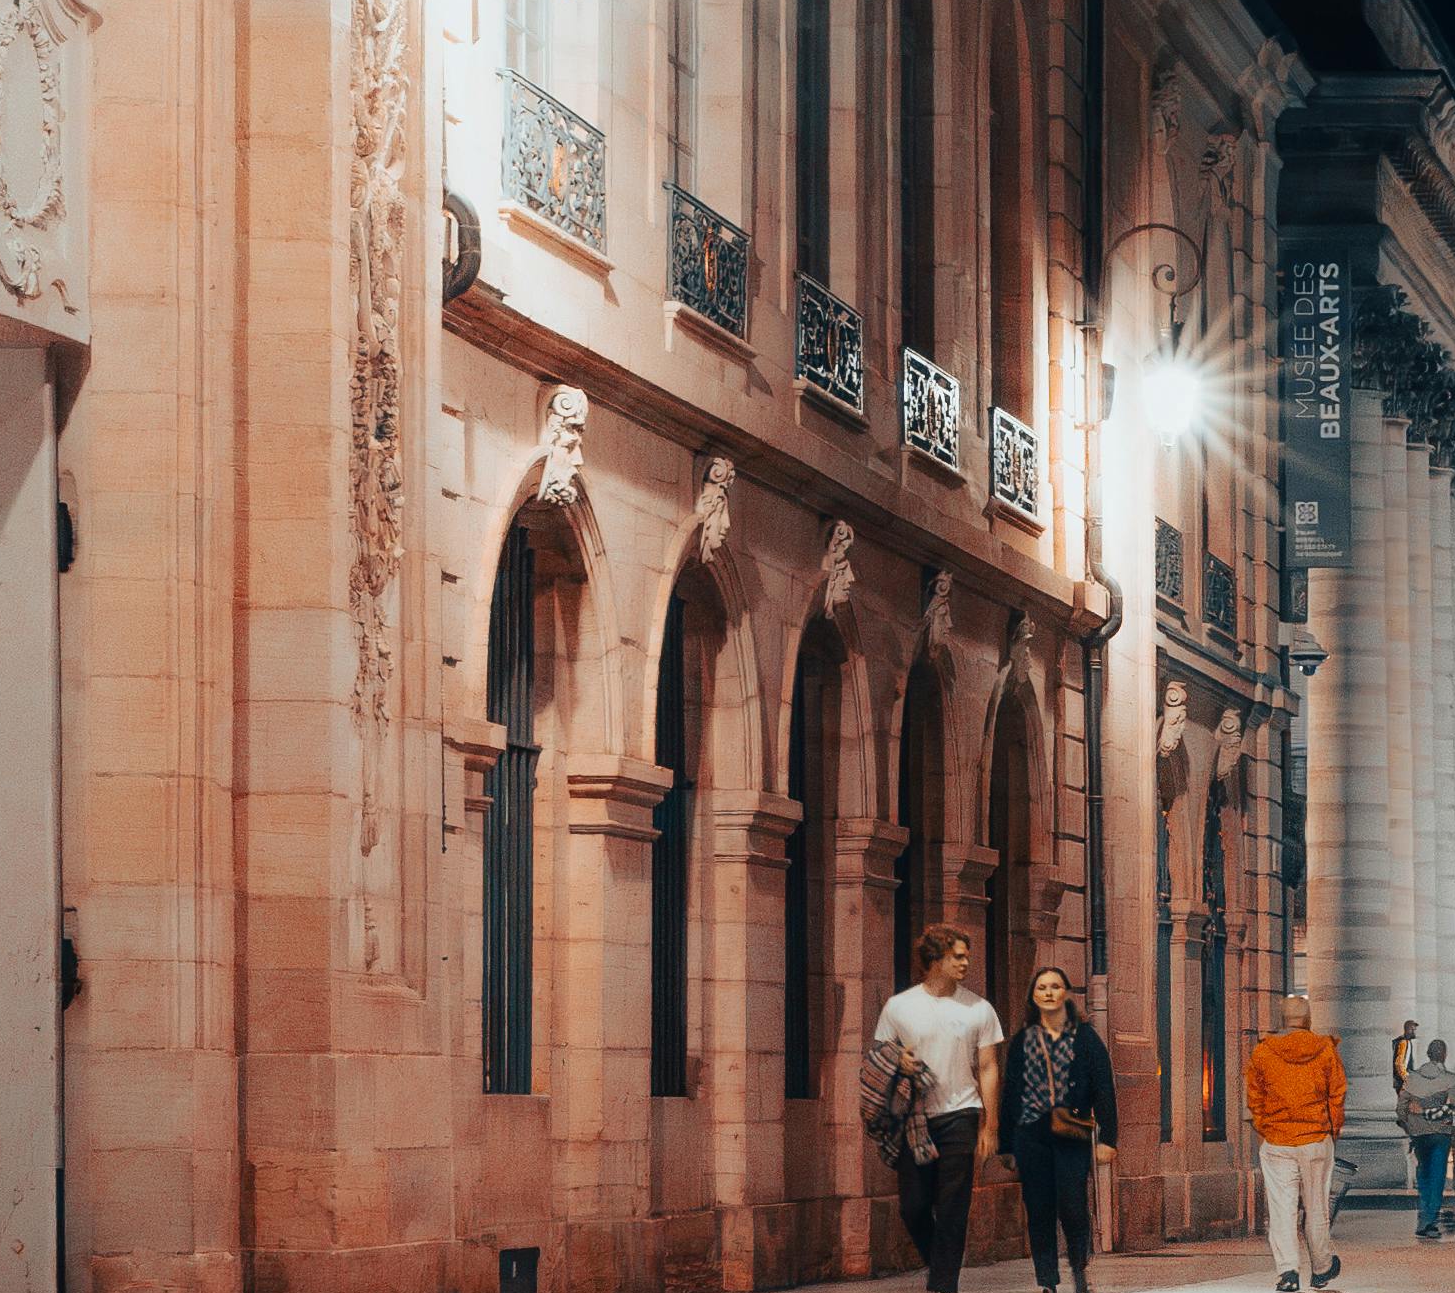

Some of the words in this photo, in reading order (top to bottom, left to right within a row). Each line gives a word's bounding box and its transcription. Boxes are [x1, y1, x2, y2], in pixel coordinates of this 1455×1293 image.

[1293, 262, 1315, 315] DES
[1291, 324, 1315, 418] MUSÉE
[1319, 262, 1341, 439] BEAUX-ARTS
